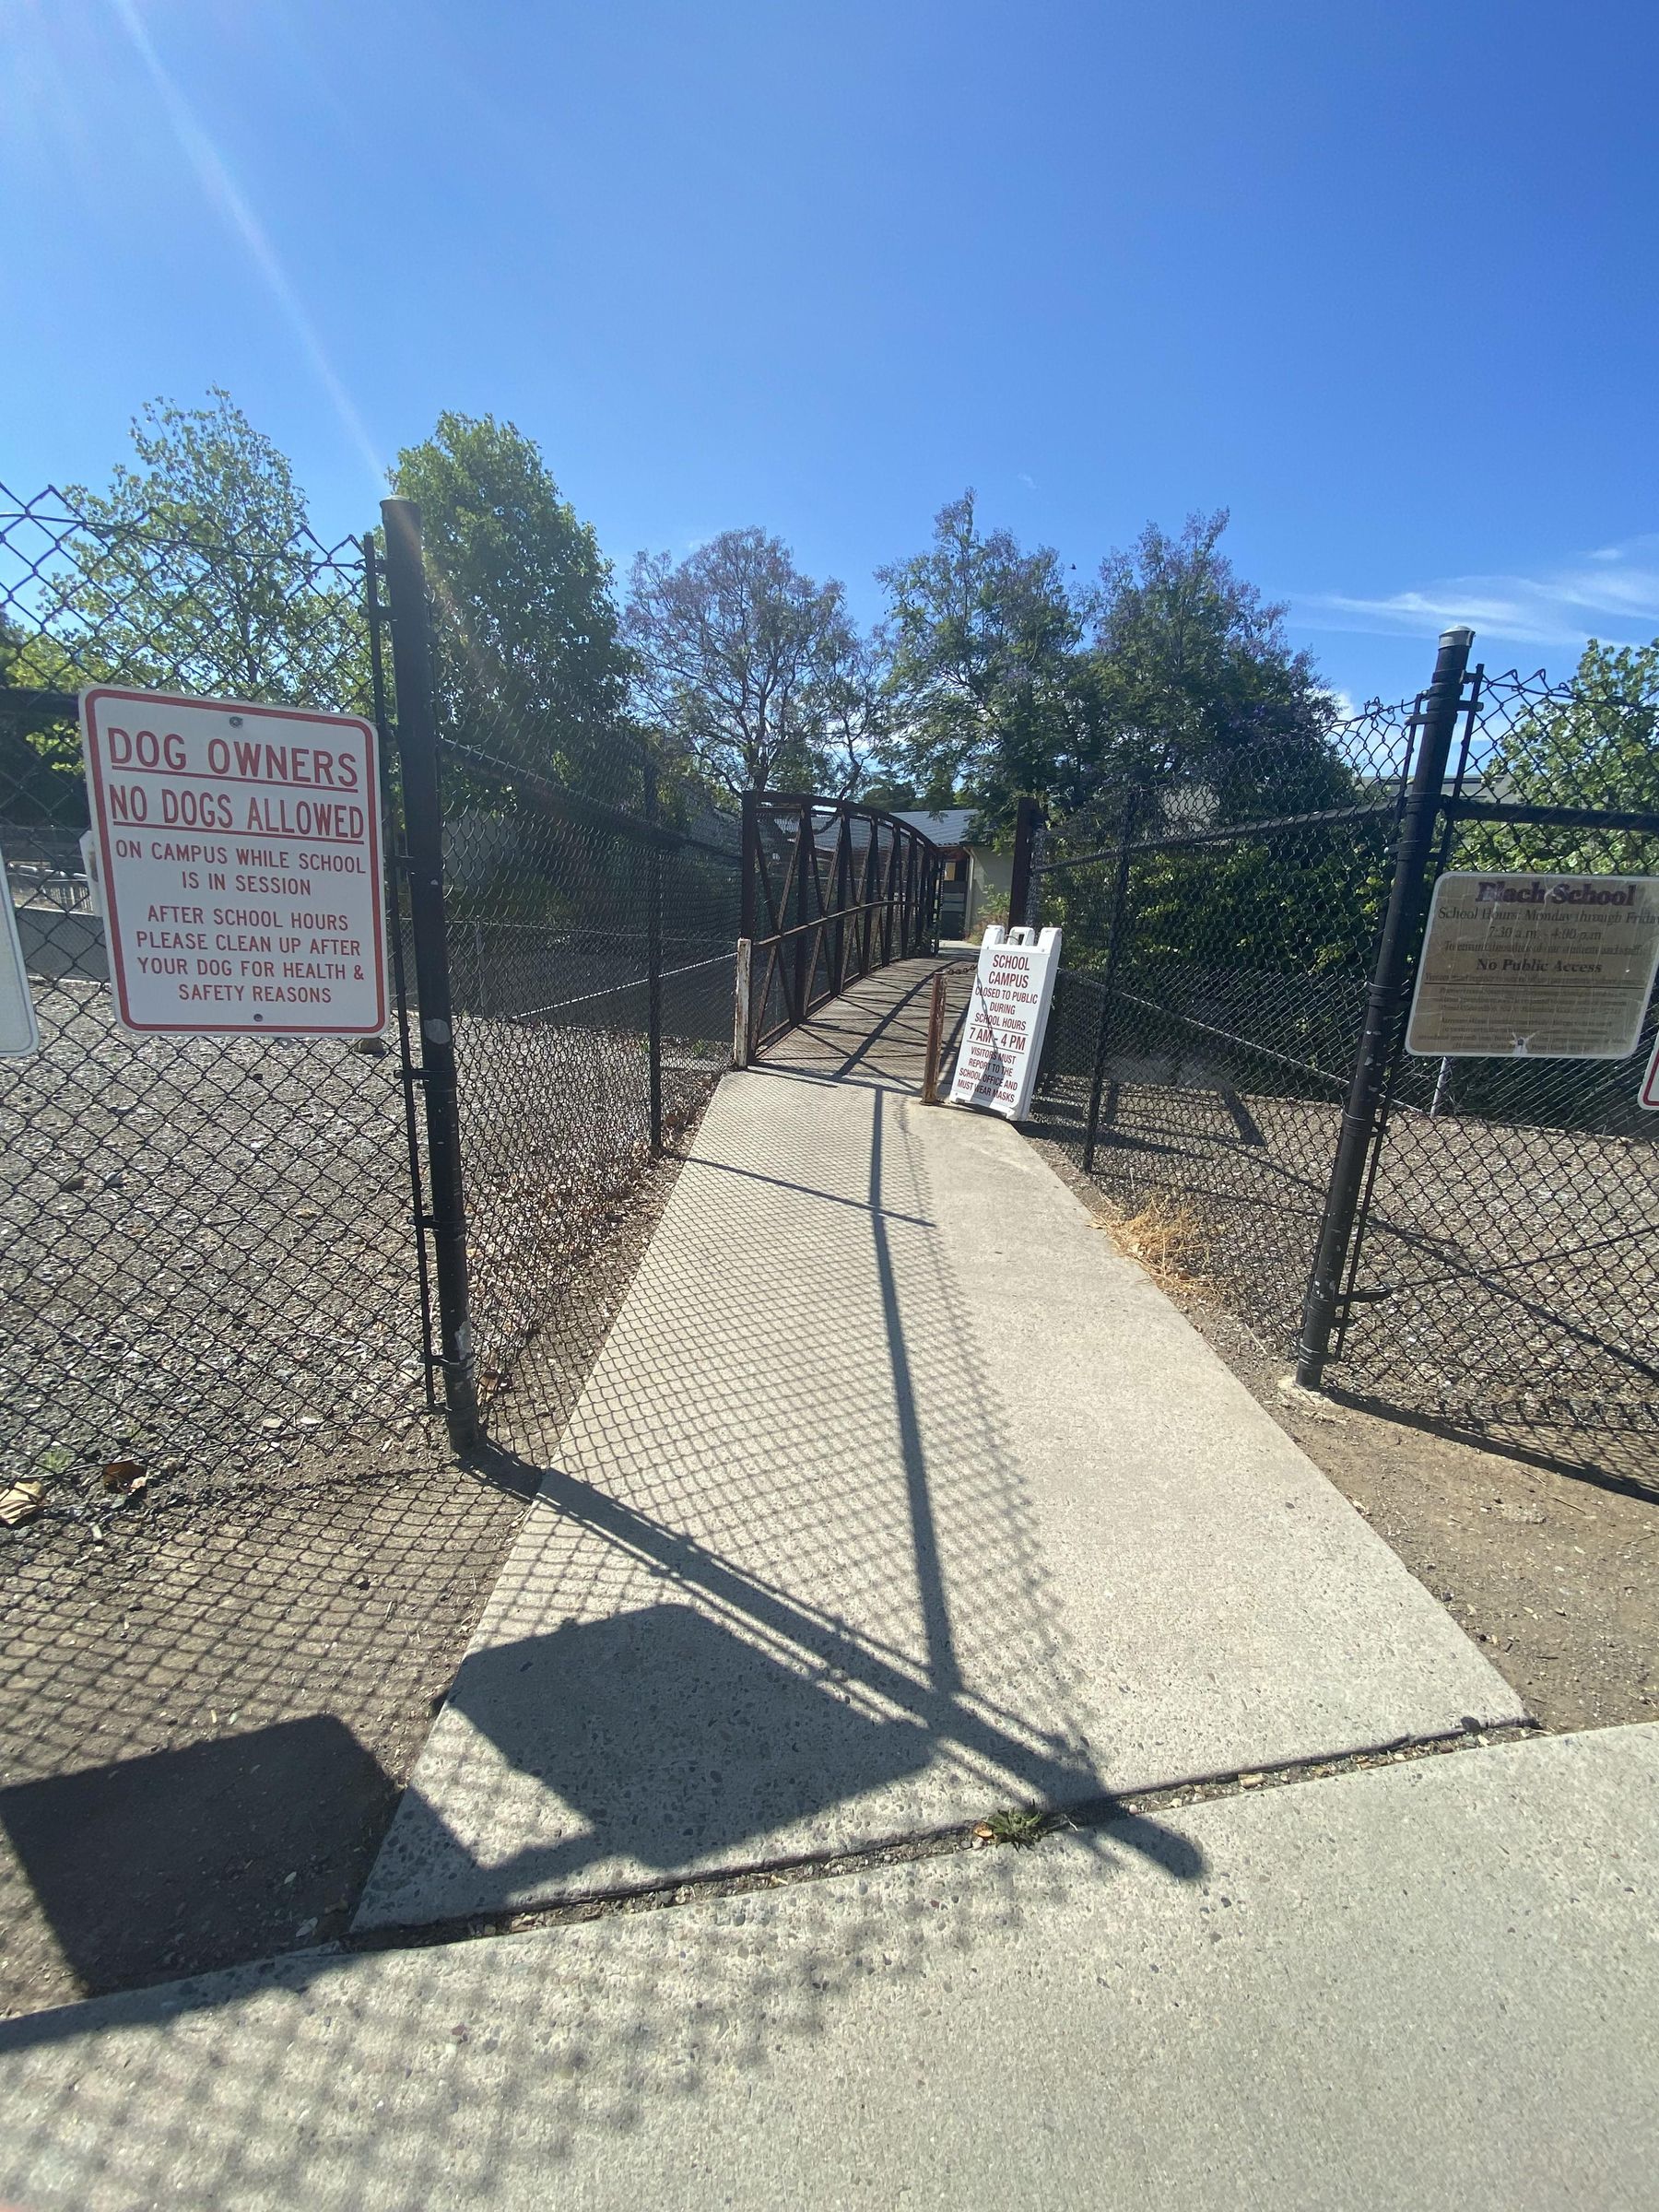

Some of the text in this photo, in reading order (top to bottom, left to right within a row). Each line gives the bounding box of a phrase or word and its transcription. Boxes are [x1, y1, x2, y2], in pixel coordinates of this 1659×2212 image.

[108, 727, 359, 787] DOG OWNERS
[109, 784, 364, 839] NO DOGS ALLOWED
[116, 840, 366, 874] ON CAMPUS WHILE SCHOOL
[182, 871, 312, 896] IS IN SESSION
[1551, 883, 1636, 906] School
[147, 905, 349, 931] AFTER SCHOOL HOURS
[1438, 907, 1478, 920] School
[1488, 925, 1512, 938] 7:30
[136, 931, 360, 957] PLEASE CLEAN UP AFTER
[137, 957, 365, 981] YOUR DOG FOR HEALTH &
[993, 954, 1030, 971] SCHOOL
[1477, 958, 1603, 973] No Public Access
[988, 971, 1030, 988] CAMPUS
[179, 983, 332, 1004] SAFETY REASONS
[975, 985, 1038, 1005] CLOSED TO PUBLIC
[989, 1002, 1016, 1015] DURING
[975, 1013, 1027, 1031] SCHOOL HOURS
[970, 1027, 976, 1039] 7
[976, 1029, 993, 1043] AM
[1001, 1033, 1007, 1046] 4
[1008, 1035, 1026, 1051] PM
[971, 1046, 1017, 1065] VISITORS MUST
[968, 1058, 1013, 1077] REPORT TO THE
[959, 1068, 1018, 1091] SCHOOL OFFICE AND
[958, 1079, 1015, 1103] MUST WEAR MASKS
